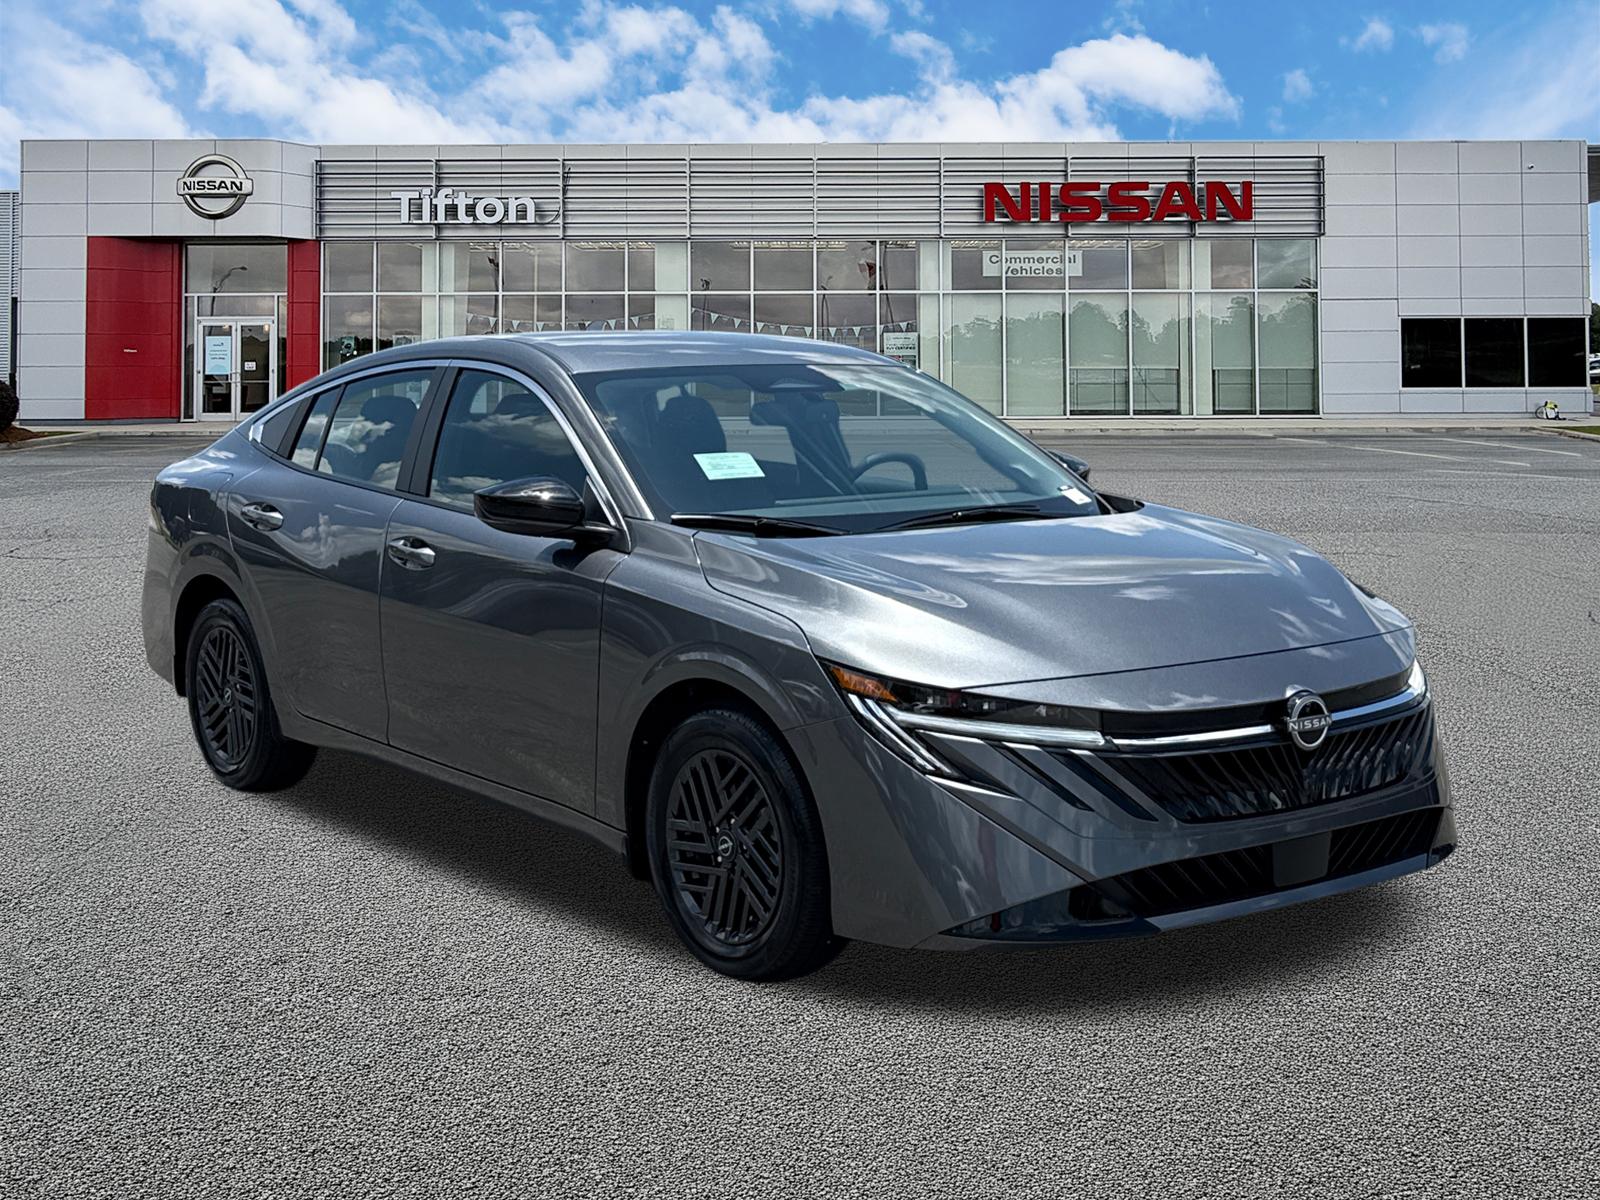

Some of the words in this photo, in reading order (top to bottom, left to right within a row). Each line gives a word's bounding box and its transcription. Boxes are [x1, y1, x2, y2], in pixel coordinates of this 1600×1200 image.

[182, 180, 243, 192] NISSAN
[390, 187, 537, 225] Tifton
[983, 180, 1254, 222] NISSAN
[1289, 716, 1332, 730] NISSAN
